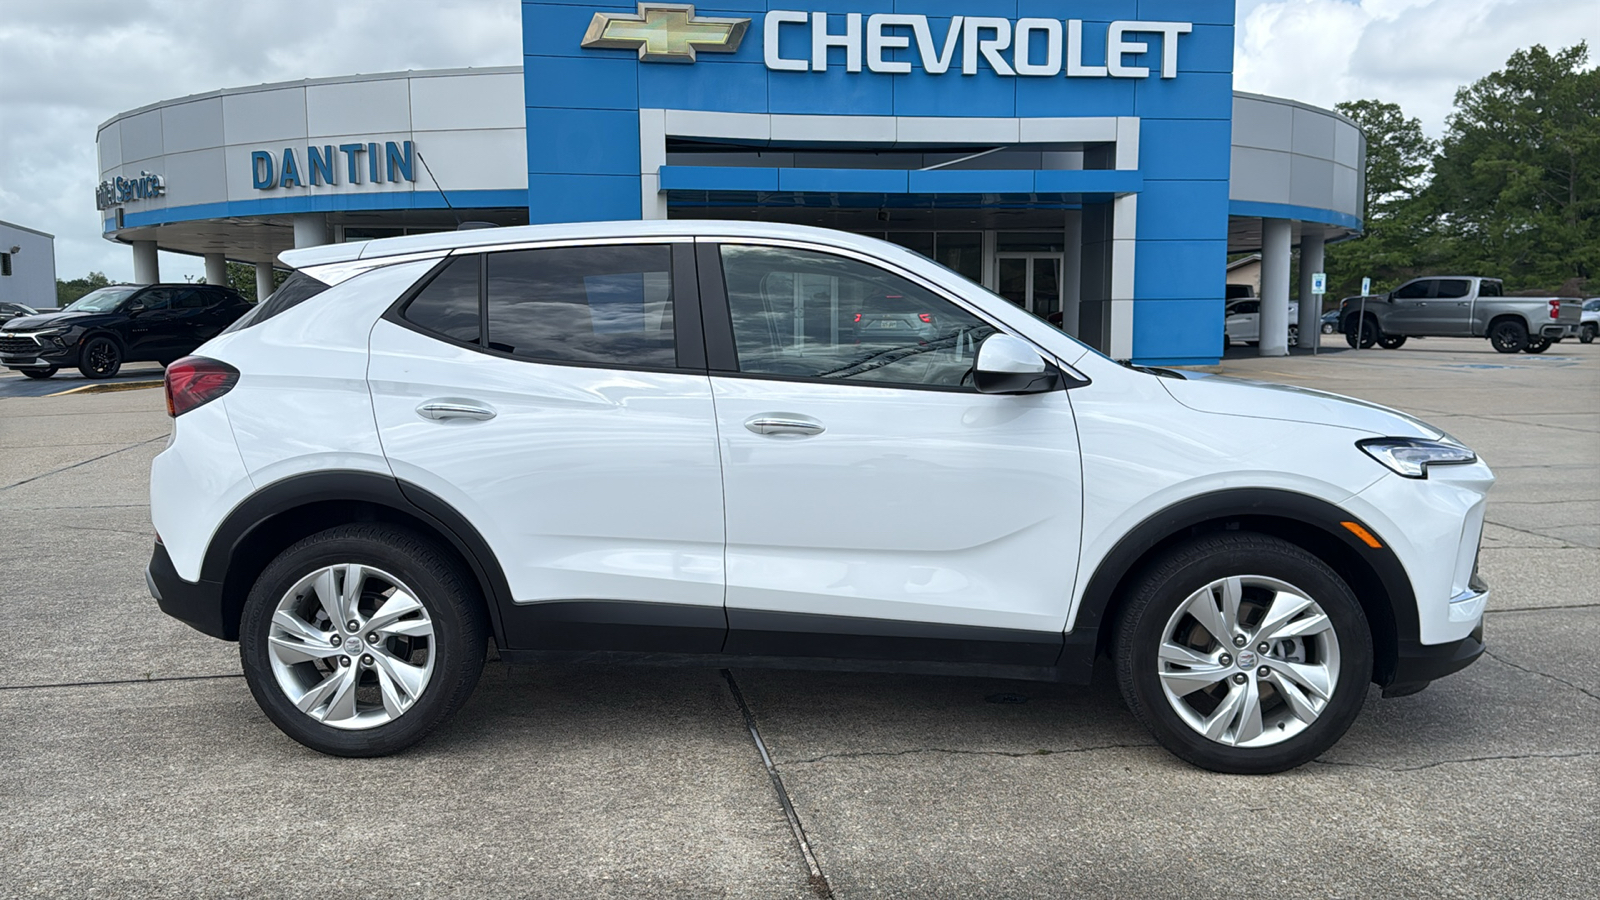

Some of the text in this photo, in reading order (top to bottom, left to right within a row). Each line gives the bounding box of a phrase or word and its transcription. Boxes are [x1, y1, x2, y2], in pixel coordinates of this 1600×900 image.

[764, 9, 1193, 79] CHEVROLET
[116, 169, 164, 202] Service
[251, 140, 415, 190] DANTIN
